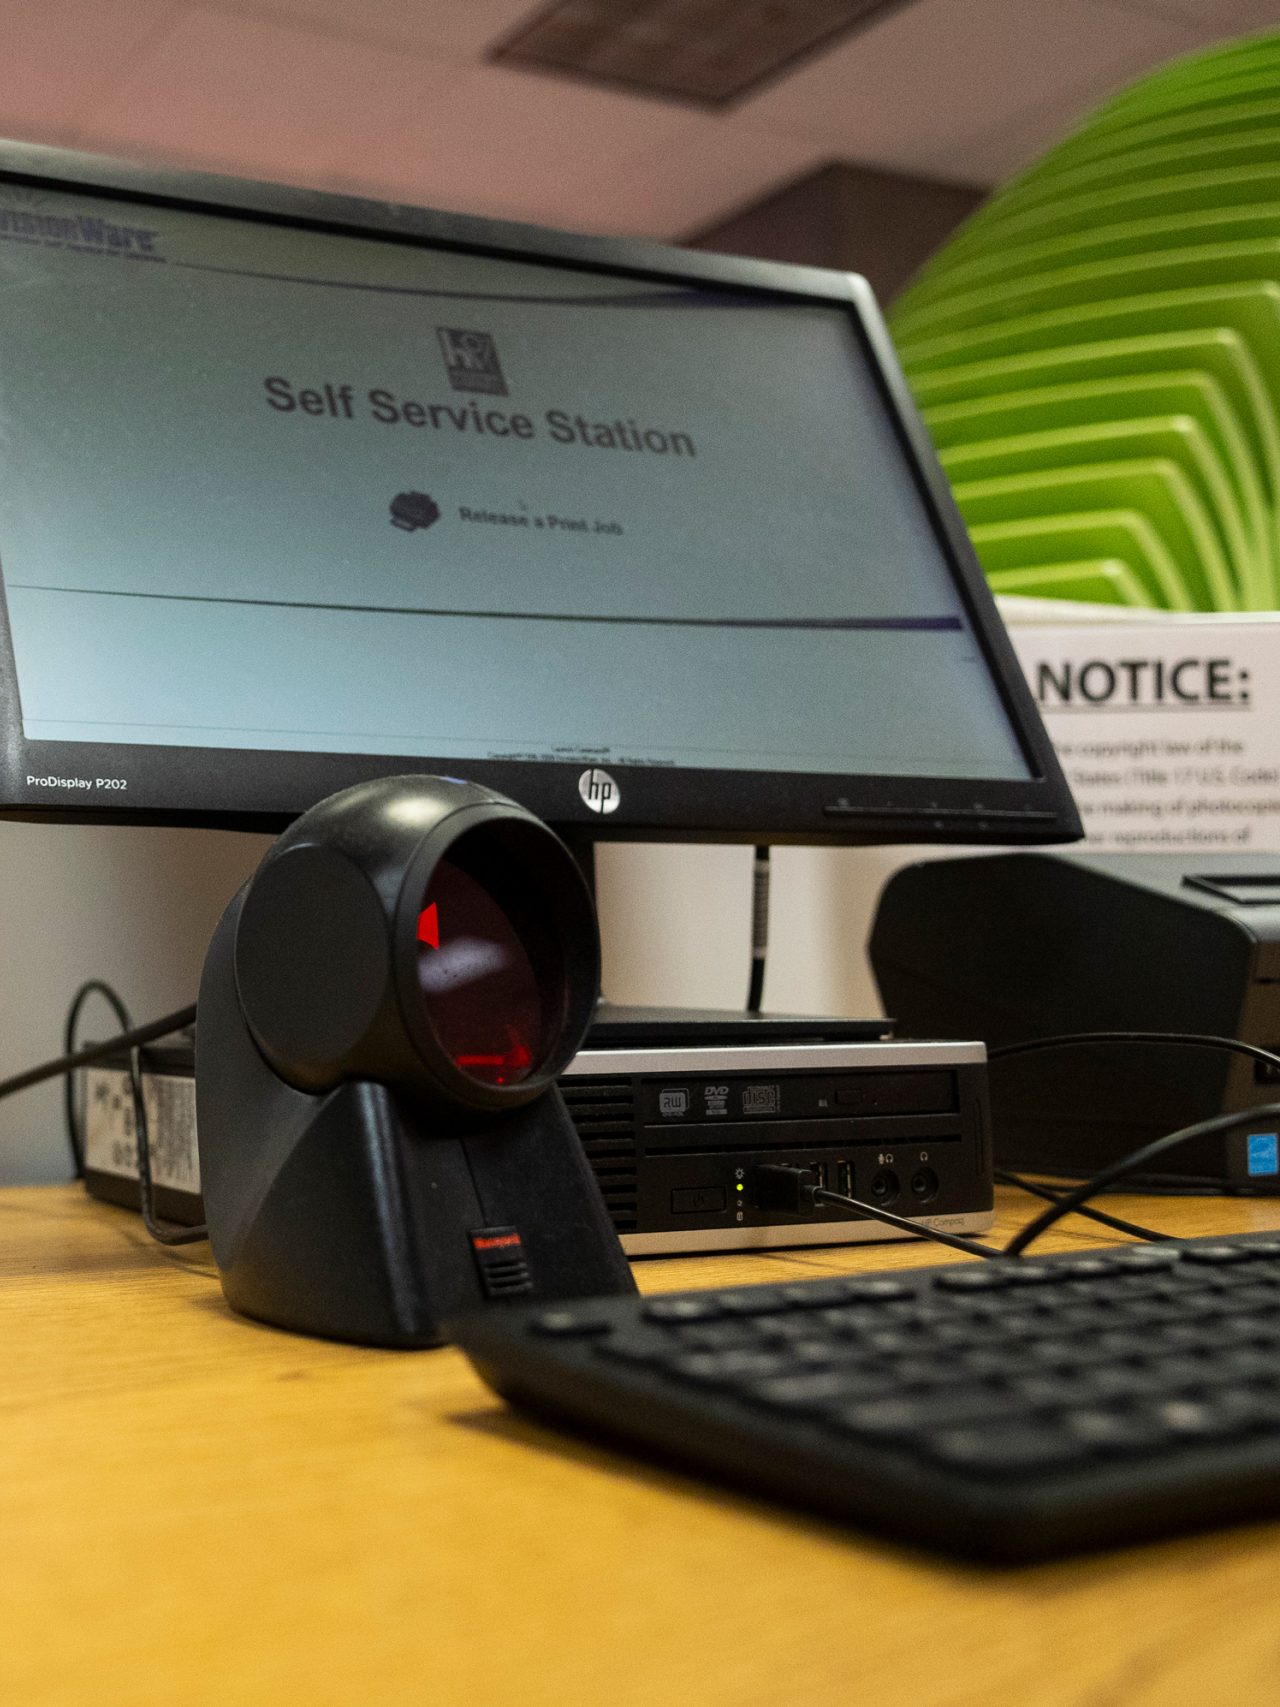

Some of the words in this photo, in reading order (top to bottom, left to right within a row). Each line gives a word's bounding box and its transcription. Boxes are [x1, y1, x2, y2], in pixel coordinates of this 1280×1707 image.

[264, 376, 353, 419] Self
[367, 389, 535, 440] Service
[546, 409, 695, 457] Station
[459, 506, 527, 527] Release
[534, 518, 544, 528] a
[547, 514, 589, 533] Print
[593, 517, 623, 536] Job
[1036, 659, 1250, 702] NOTICE:
[26, 775, 92, 790] ProDisplay
[96, 778, 127, 789] P202
[588, 769, 612, 814] hp
[703, 1086, 729, 1096] DVD
